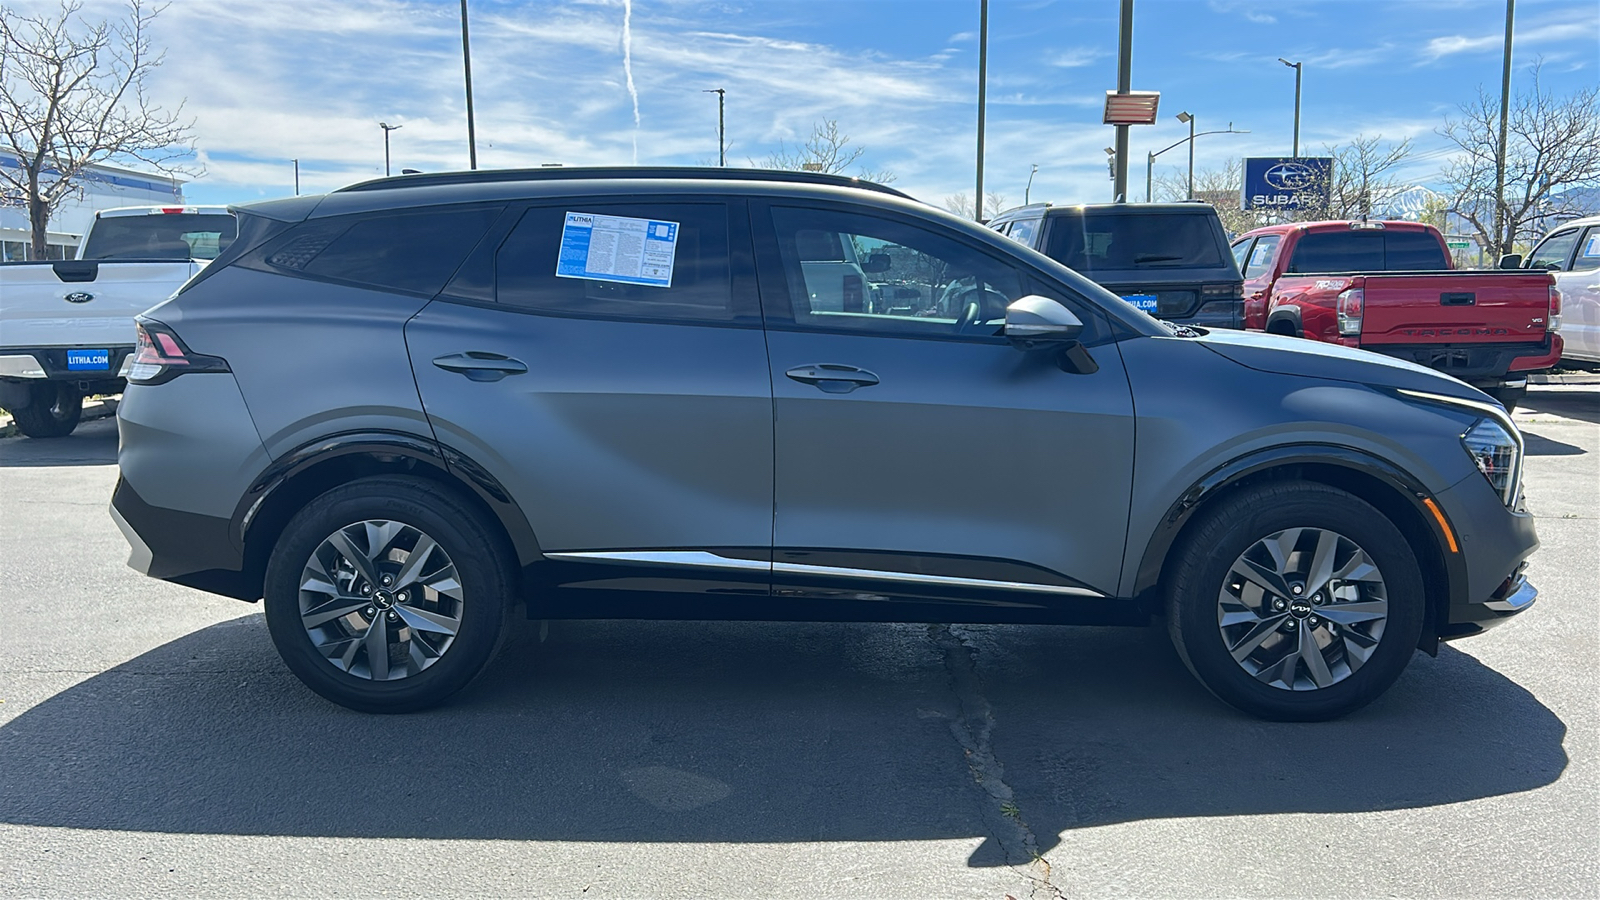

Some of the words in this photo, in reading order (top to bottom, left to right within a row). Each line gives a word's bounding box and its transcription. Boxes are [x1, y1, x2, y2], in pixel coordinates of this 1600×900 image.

[1253, 194, 1327, 206] SUBAR
[1403, 328, 1508, 336] TACOMA
[68, 356, 108, 365] LITHIA.COM
